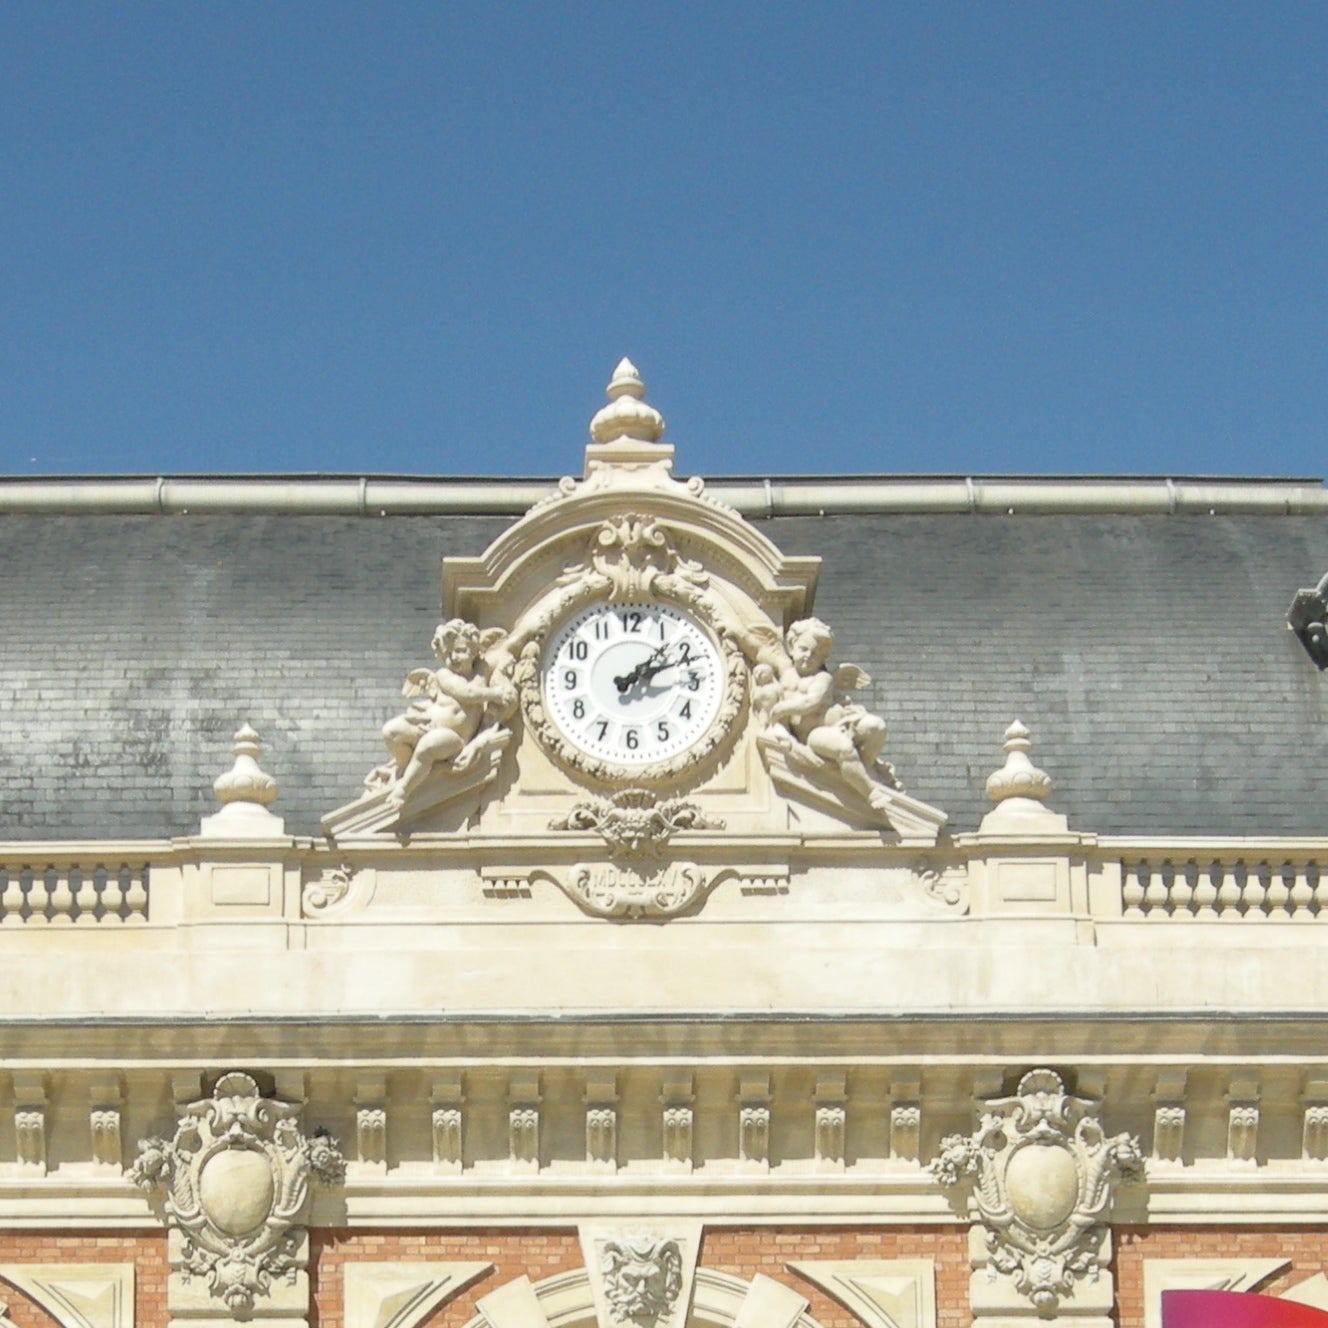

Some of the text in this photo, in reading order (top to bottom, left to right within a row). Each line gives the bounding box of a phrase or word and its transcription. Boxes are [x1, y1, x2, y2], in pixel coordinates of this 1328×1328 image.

[594, 622, 609, 640] 11
[622, 612, 642, 633] 12
[569, 640, 588, 661] 10
[679, 642, 691, 667] 2
[564, 671, 577, 691] 9
[688, 671, 700, 692] 3
[572, 699, 585, 720] 8
[679, 699, 692, 721] 4
[596, 721, 609, 742] 7
[625, 729, 639, 750] 6
[657, 721, 670, 742] 5
